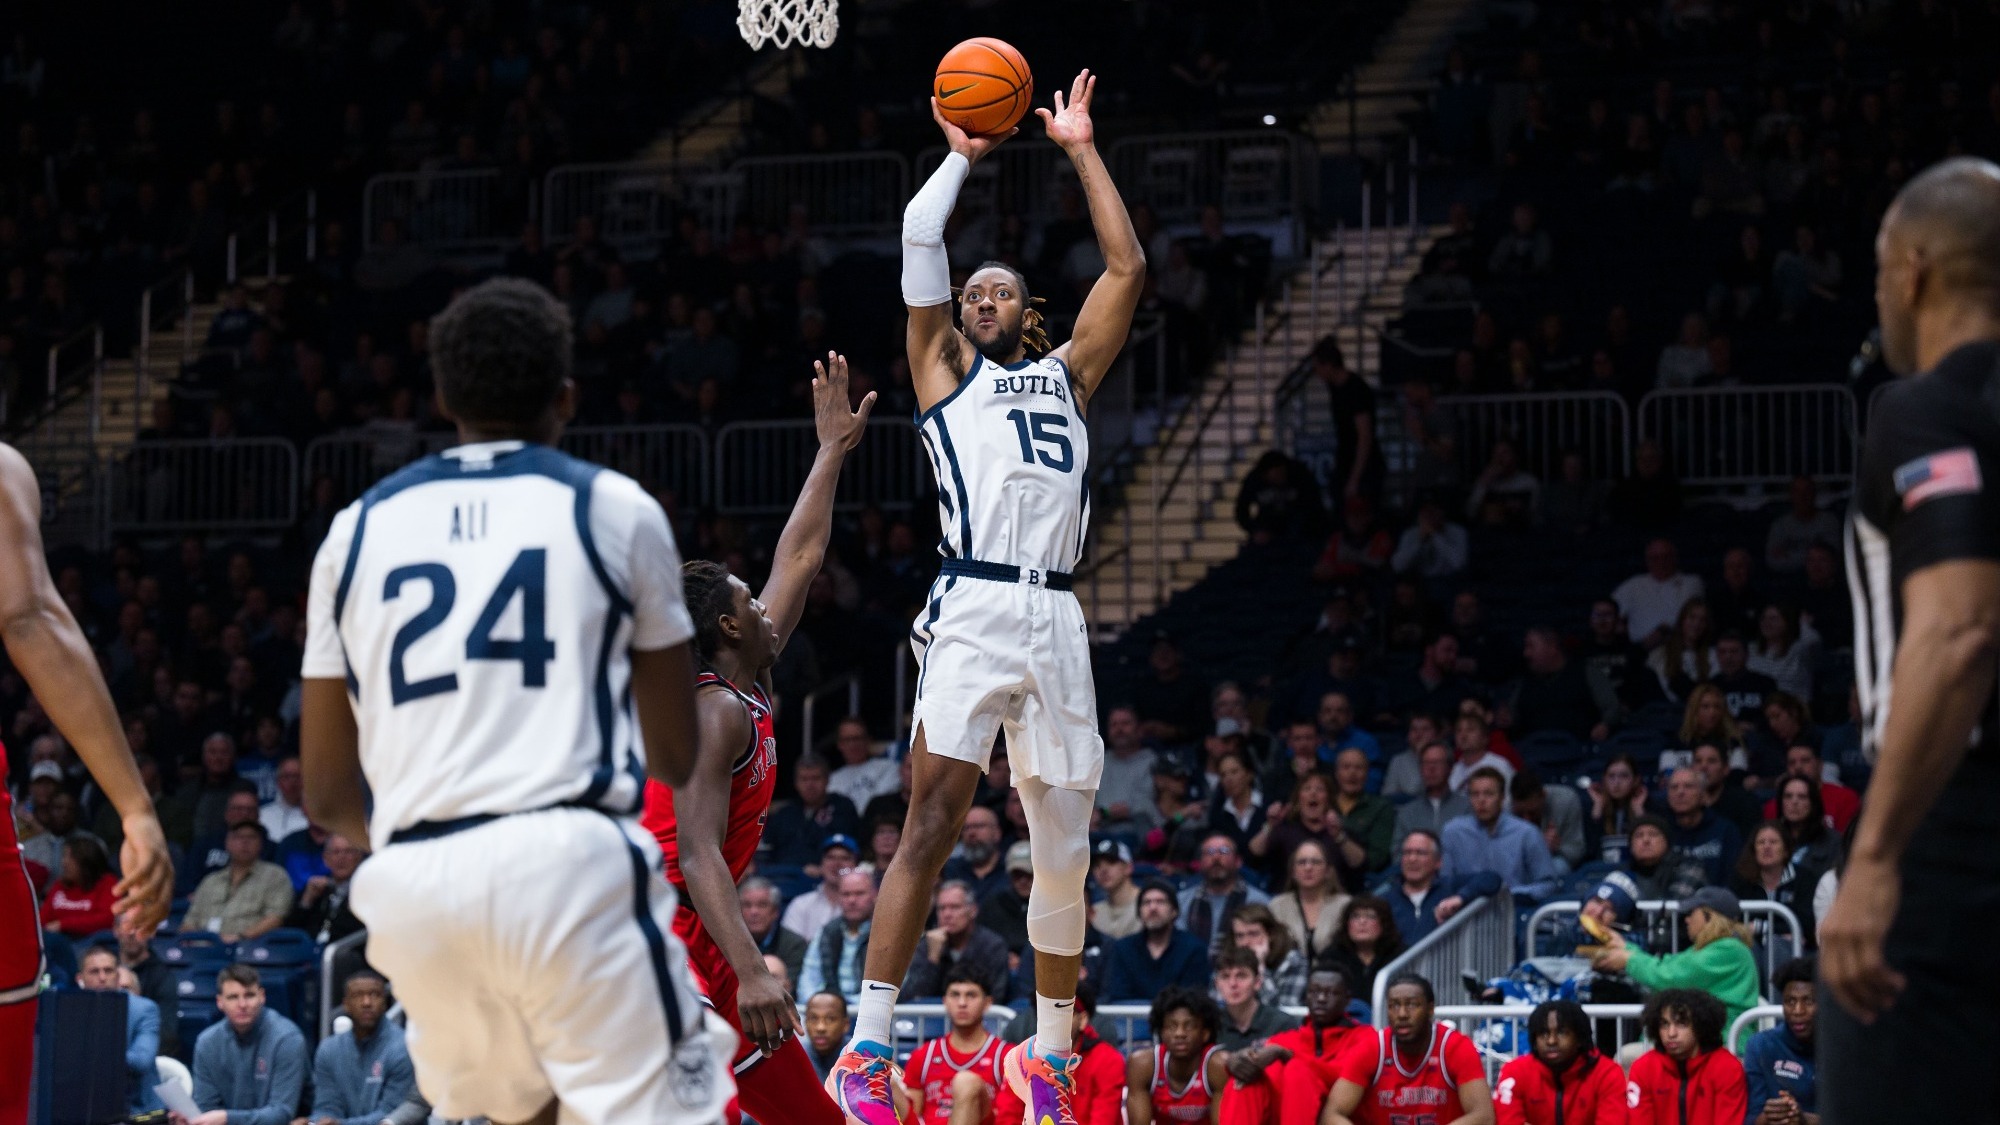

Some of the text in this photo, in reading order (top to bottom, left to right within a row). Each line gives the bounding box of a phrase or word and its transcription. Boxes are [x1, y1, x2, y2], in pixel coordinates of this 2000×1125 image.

[994, 375, 1067, 404] BUTLE
[1006, 409, 1074, 474] 15
[449, 501, 487, 543] ALI
[1028, 569, 1039, 585] B
[382, 546, 556, 707] 24
